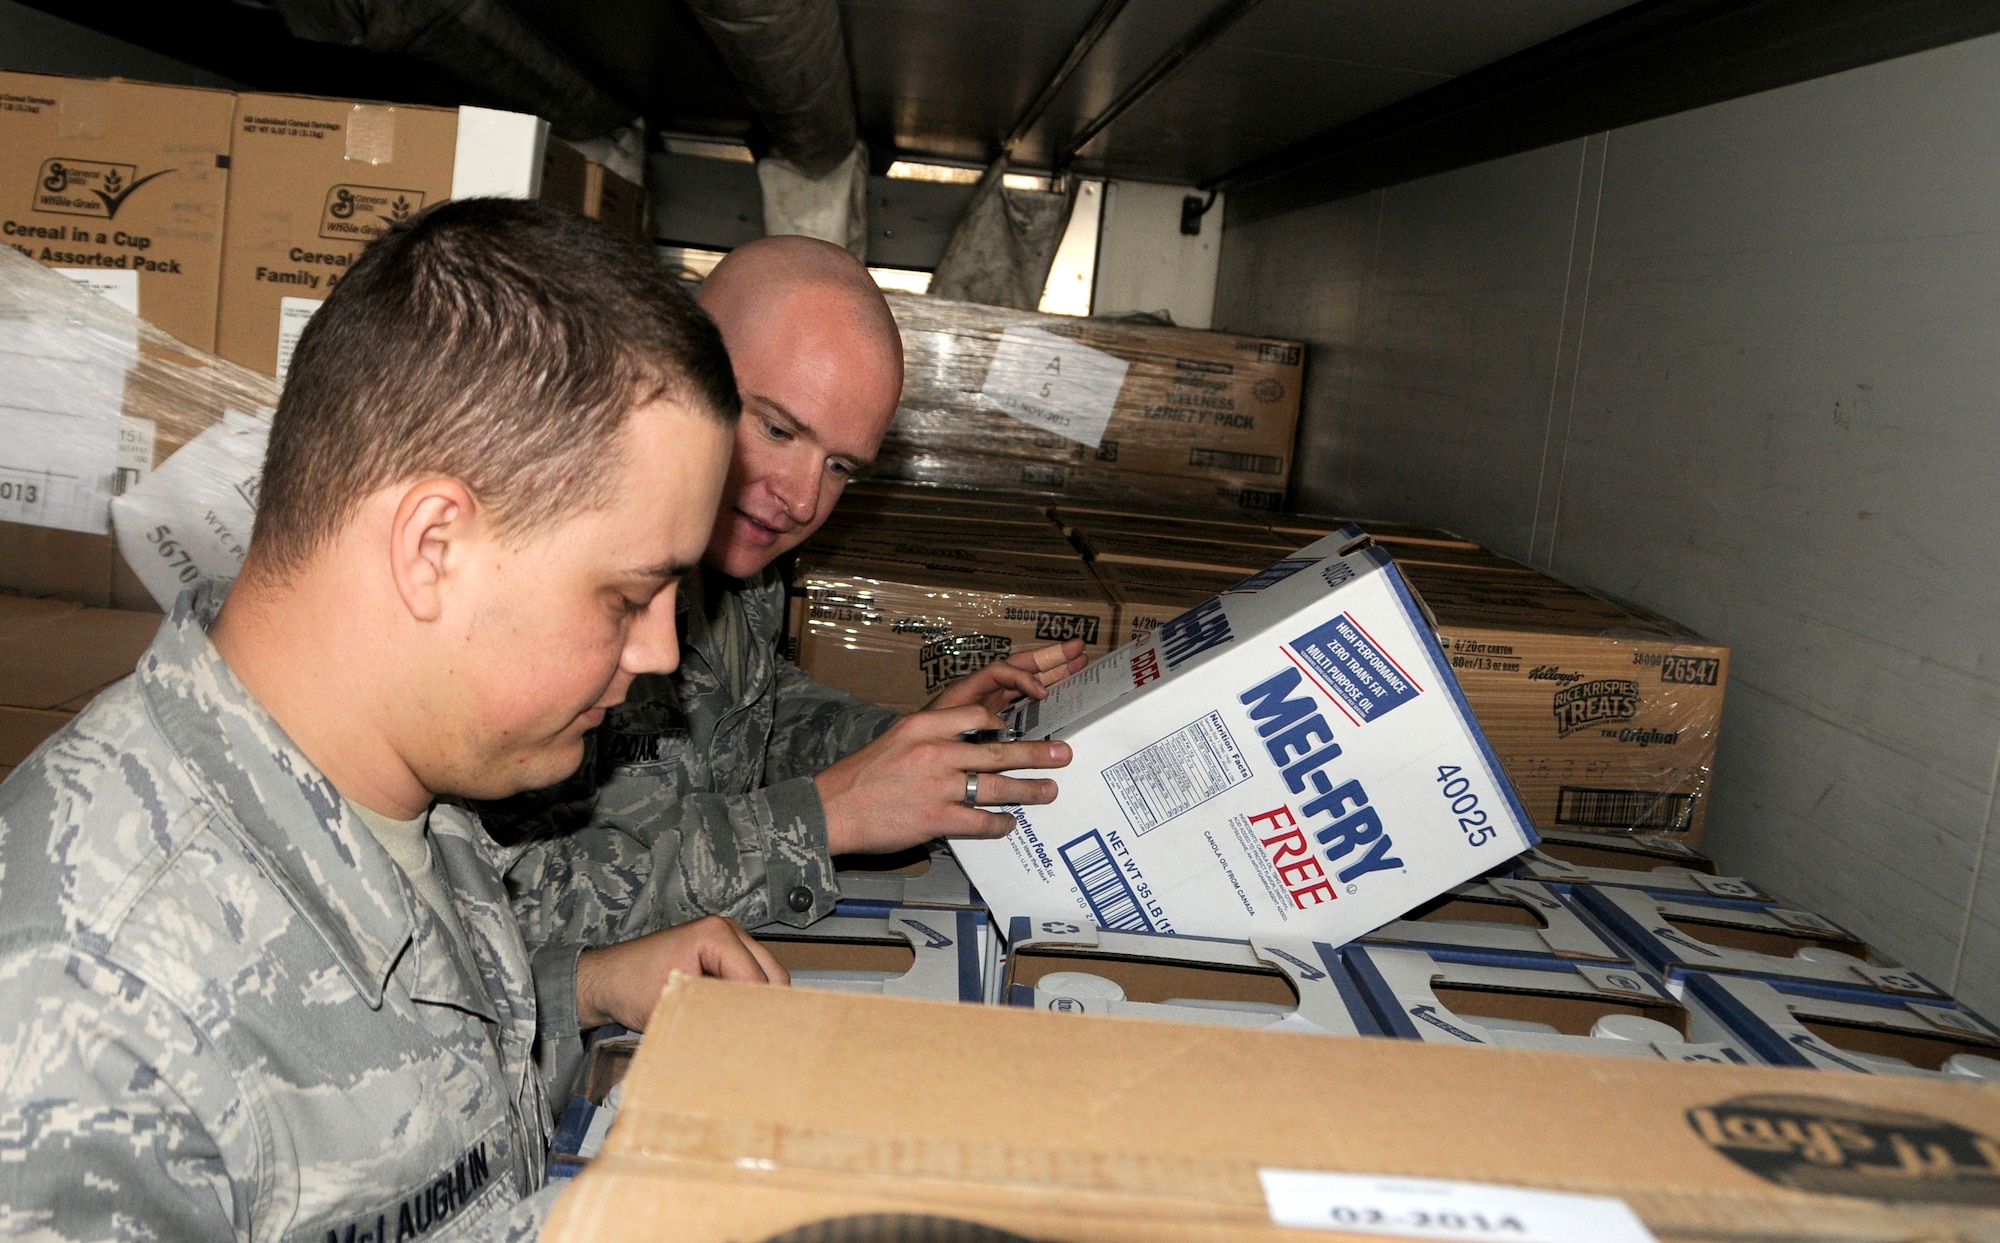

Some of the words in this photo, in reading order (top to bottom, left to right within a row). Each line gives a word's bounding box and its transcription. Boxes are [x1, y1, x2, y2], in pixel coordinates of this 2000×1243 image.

[40, 195, 72, 208] Whole
[73, 198, 100, 210] Grain
[355, 194, 387, 204] General
[3, 220, 65, 240] Cereal
[72, 227, 89, 243] in
[95, 232, 107, 244] a
[113, 232, 152, 250] Cup
[326, 222, 359, 234] Whole
[40, 247, 126, 268] Assorted
[133, 255, 182, 274] Pack
[289, 247, 353, 266] Cereal
[255, 266, 320, 289] Family
[1044, 355, 1062, 376] A
[1213, 412, 1255, 429] PACK
[205, 510, 234, 545] WTC
[146, 525, 199, 584] 5670
[1039, 612, 1099, 643] 26547
[1326, 638, 1350, 662] ZERO
[1345, 657, 1373, 685] TRANS
[1335, 621, 1358, 644] HIGH
[1352, 639, 1407, 695] PERFORMANCE
[1487, 645, 1513, 655] CARTON
[1305, 643, 1332, 669] MULTI
[1326, 665, 1363, 701] PURPOSE
[1357, 697, 1375, 714] OIL
[1528, 665, 1585, 686] Kellogg's
[1632, 653, 1662, 666] 38000
[1663, 656, 1719, 684] 26547
[1555, 687, 1580, 707] RICE
[1583, 681, 1639, 697] KRISPIES
[1555, 696, 1637, 734] TREATS
[1208, 713, 1234, 752] Nutrition
[1231, 753, 1249, 778] Facts
[1619, 728, 1679, 747] Original
[1237, 666, 1404, 884] MEL-FRY
[1436, 765, 1496, 847] 40025
[1012, 806, 1039, 844] Ventura
[1017, 834, 1026, 845] and
[1030, 857, 1039, 868] that
[1232, 815, 1242, 828] ACID
[1251, 849, 1266, 871] PROTECT
[1248, 803, 1338, 910] FREE
[1255, 843, 1269, 862] CANOLA
[1106, 830, 1129, 859] NET
[1122, 858, 1142, 882] WT
[1135, 881, 1152, 899] 35
[1145, 899, 1163, 918] LB
[1203, 830, 1222, 858] CANOLA
[1218, 857, 1229, 869] OIL
[1225, 869, 1240, 889] FROM
[1236, 888, 1255, 916] CANADA
[1267, 889, 1279, 905] AGENT
